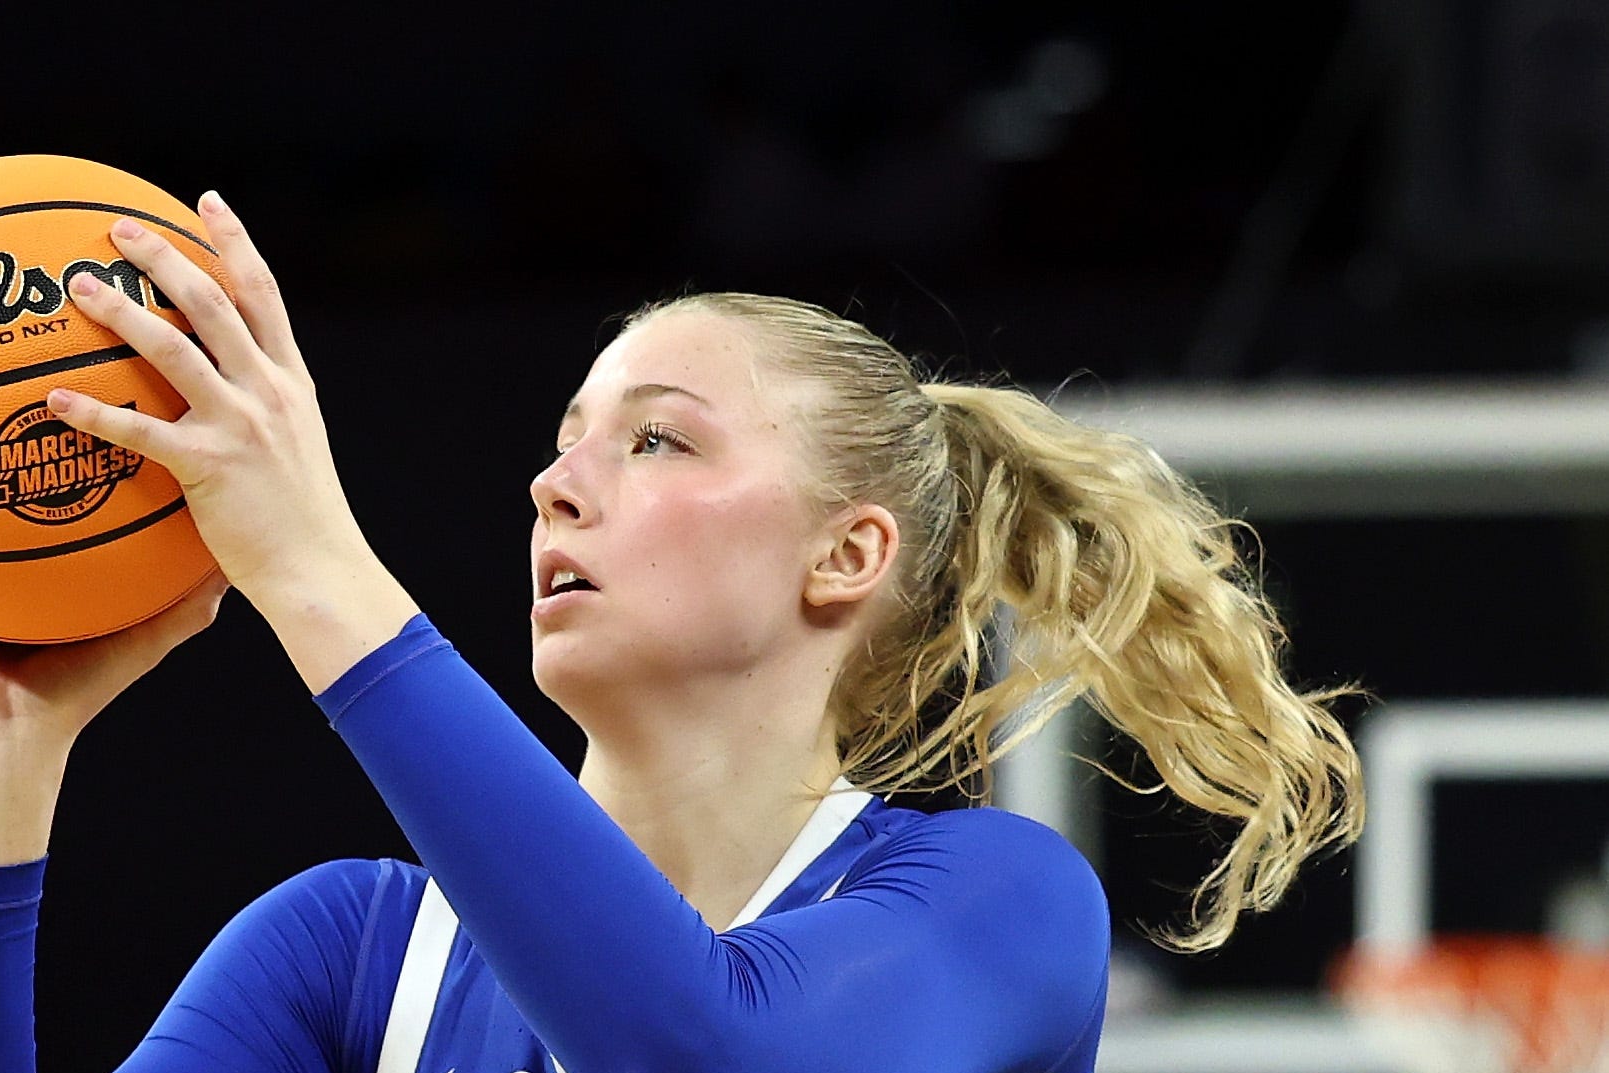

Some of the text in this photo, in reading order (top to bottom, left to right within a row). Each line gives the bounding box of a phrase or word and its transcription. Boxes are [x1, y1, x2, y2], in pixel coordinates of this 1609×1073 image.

[22, 318, 70, 340] NXT
[16, 409, 48, 429] SWEET
[0, 430, 93, 471] MARCH
[18, 447, 140, 494] MADNESS
[46, 506, 75, 518] ELITE
